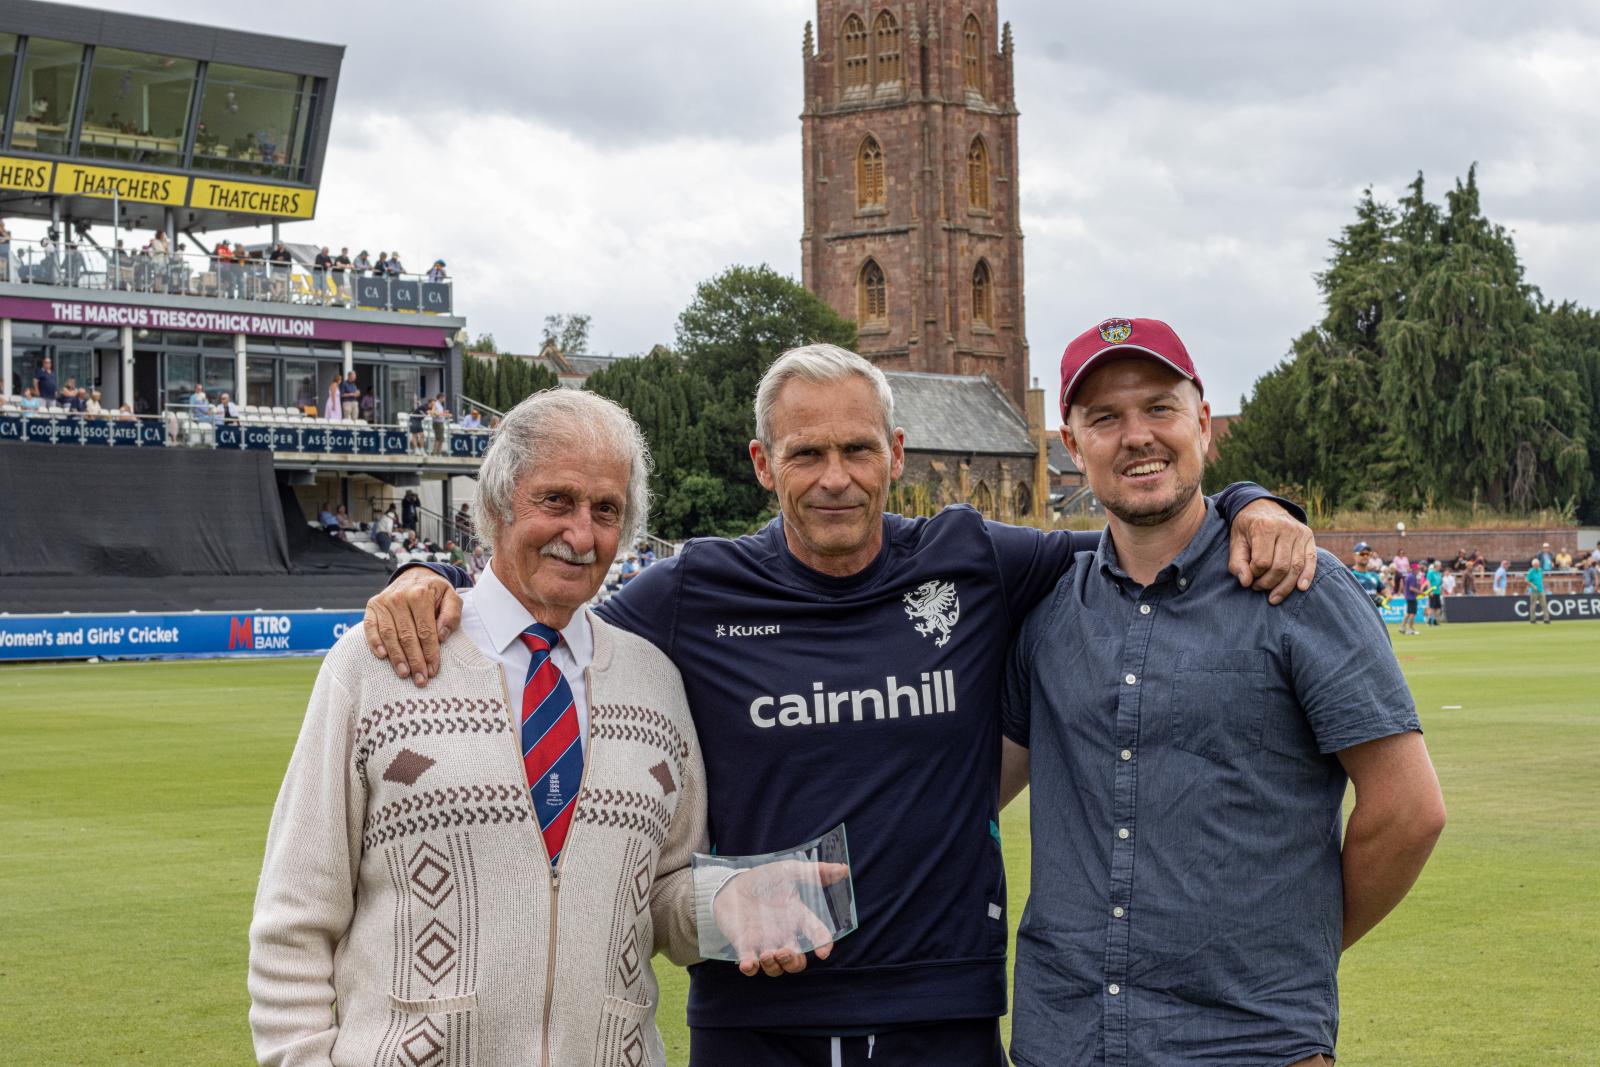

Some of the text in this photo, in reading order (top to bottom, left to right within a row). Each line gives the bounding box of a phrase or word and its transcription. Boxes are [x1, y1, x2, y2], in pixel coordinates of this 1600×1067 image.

[73, 169, 171, 201] THATCHERS
[209, 184, 300, 214] THATCHERS
[364, 286, 379, 299] CA
[396, 289, 411, 301] CA
[428, 291, 442, 304] CA
[51, 302, 315, 336] THE MARCUS TRESCOTHICK PAVILION
[0, 422, 18, 436] CA
[144, 427, 161, 441] CA
[220, 430, 237, 444] CA
[249, 432, 375, 447] COOPER ASSOCIATES
[387, 436, 402, 449] CA
[454, 439, 469, 452] CA
[56, 628, 83, 646] and
[128, 626, 179, 643] Cricket
[228, 616, 292, 650] METRO
[729, 624, 781, 637] KUKRI
[254, 636, 290, 649] BANK
[749, 669, 956, 729] cairnhill
